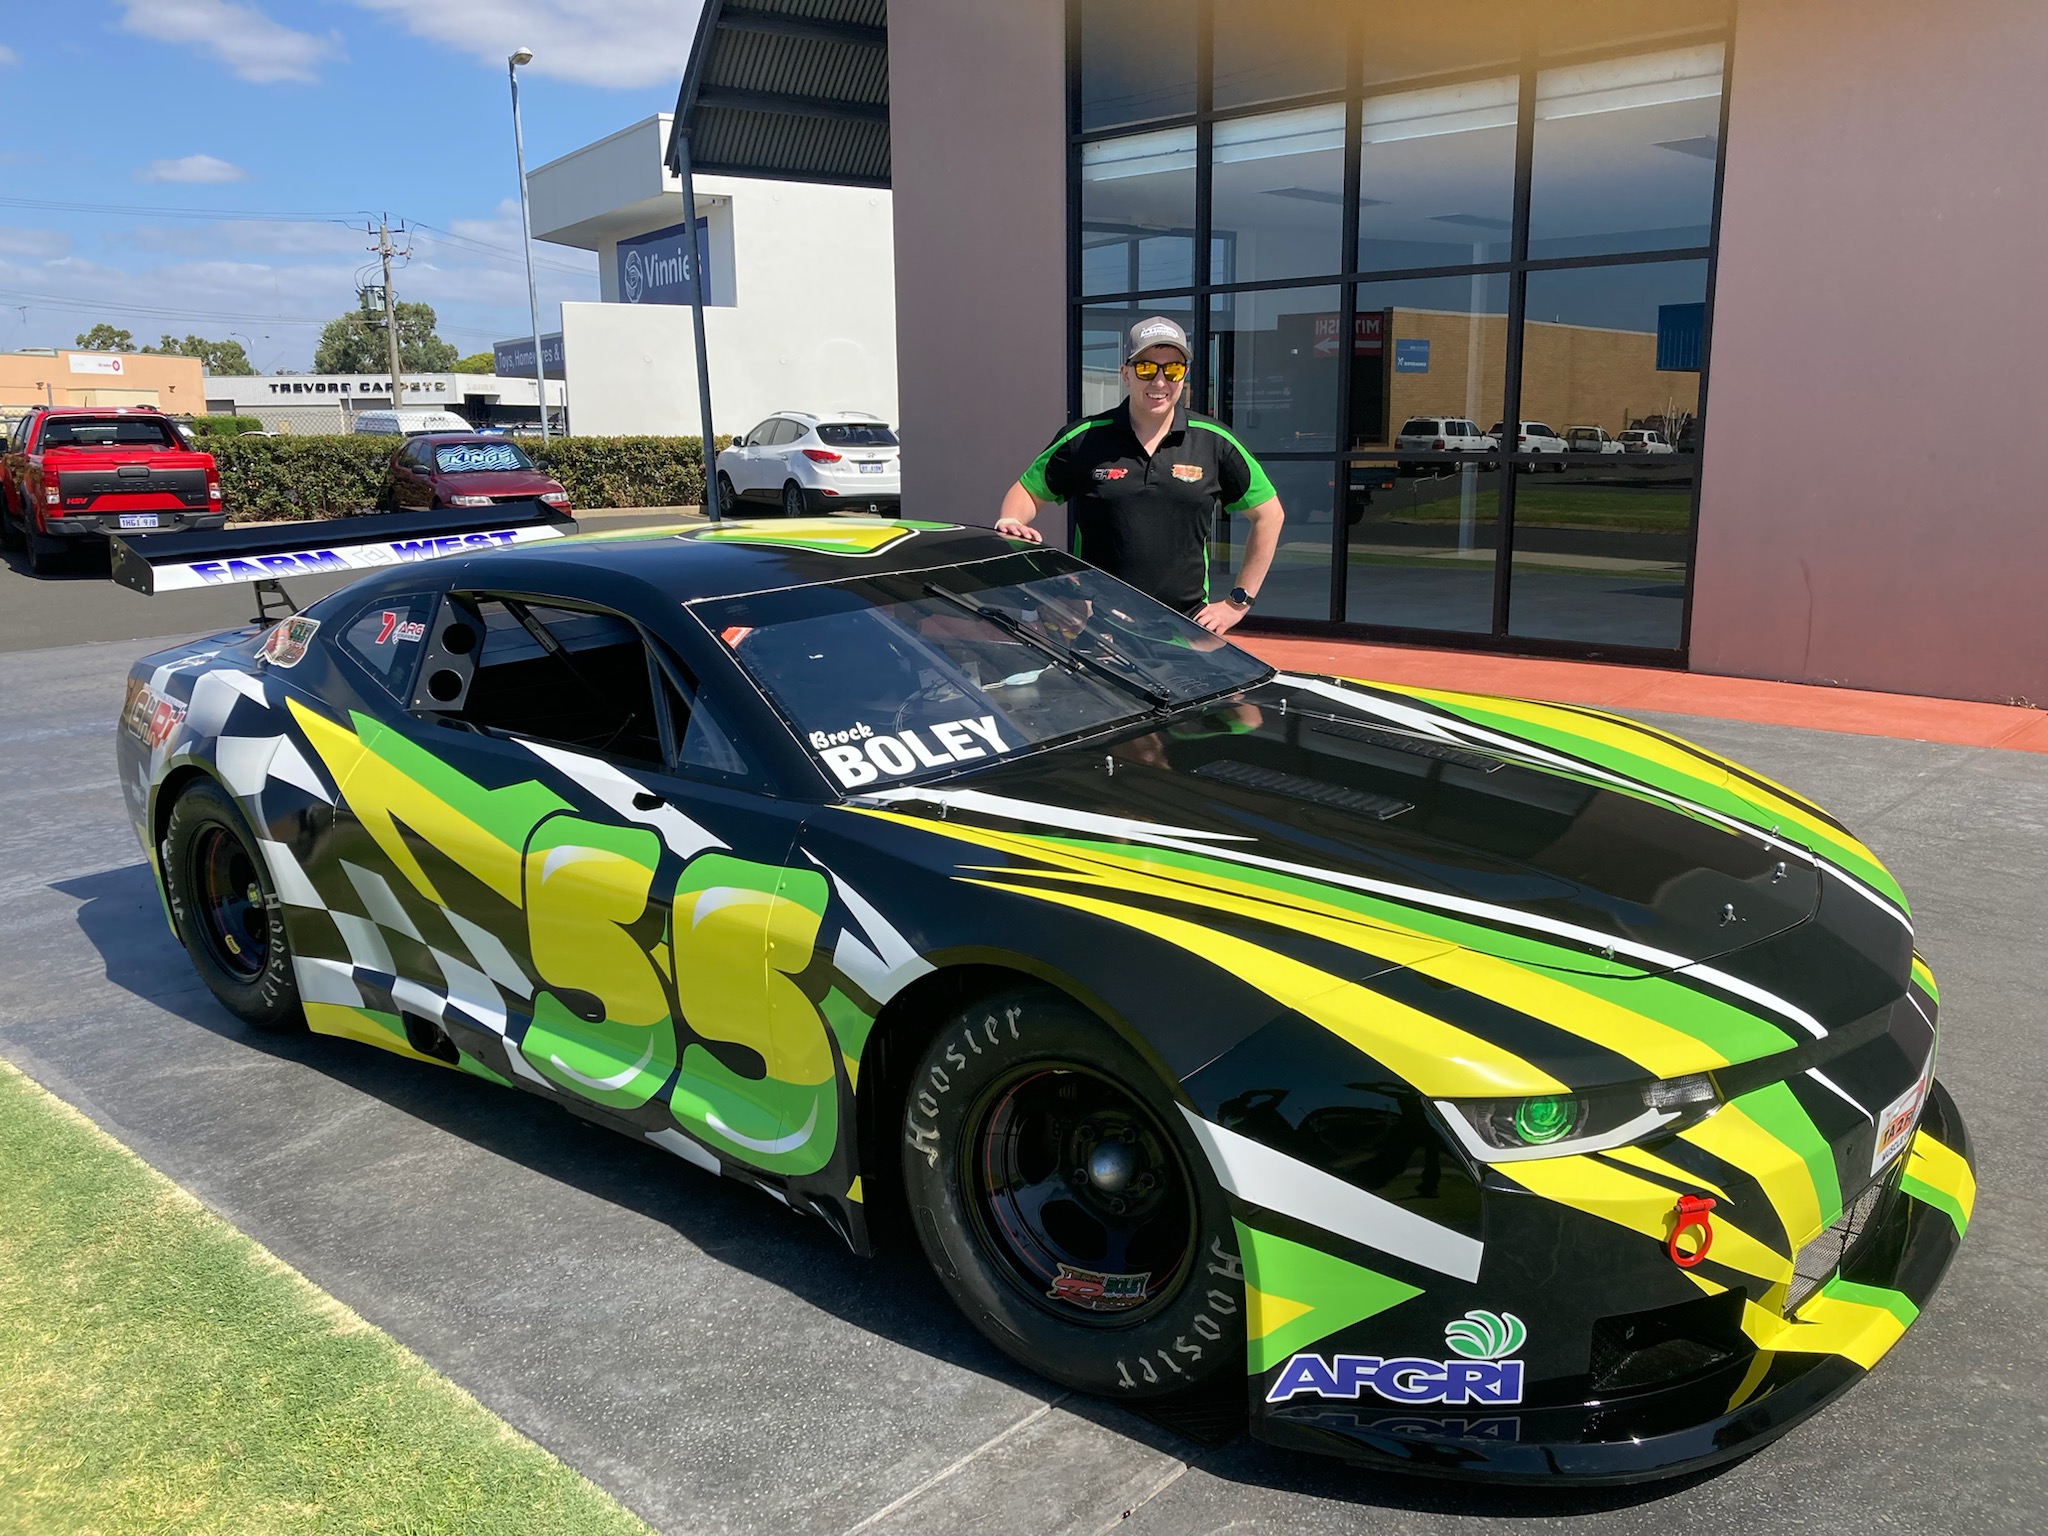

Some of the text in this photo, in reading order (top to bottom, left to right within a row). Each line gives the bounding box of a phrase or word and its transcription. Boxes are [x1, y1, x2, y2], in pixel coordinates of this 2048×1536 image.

[553, 343, 561, 362] &
[66, 497, 89, 505] HSV
[190, 531, 518, 584] FARM WEST
[398, 623, 424, 635] ARG
[808, 721, 875, 750] Brock
[818, 715, 1011, 789] BOLEY
[906, 1006, 1022, 1169] Hoosier
[1117, 1236, 1245, 1390] Hoosier
[1266, 1354, 1525, 1404] AFGRI
